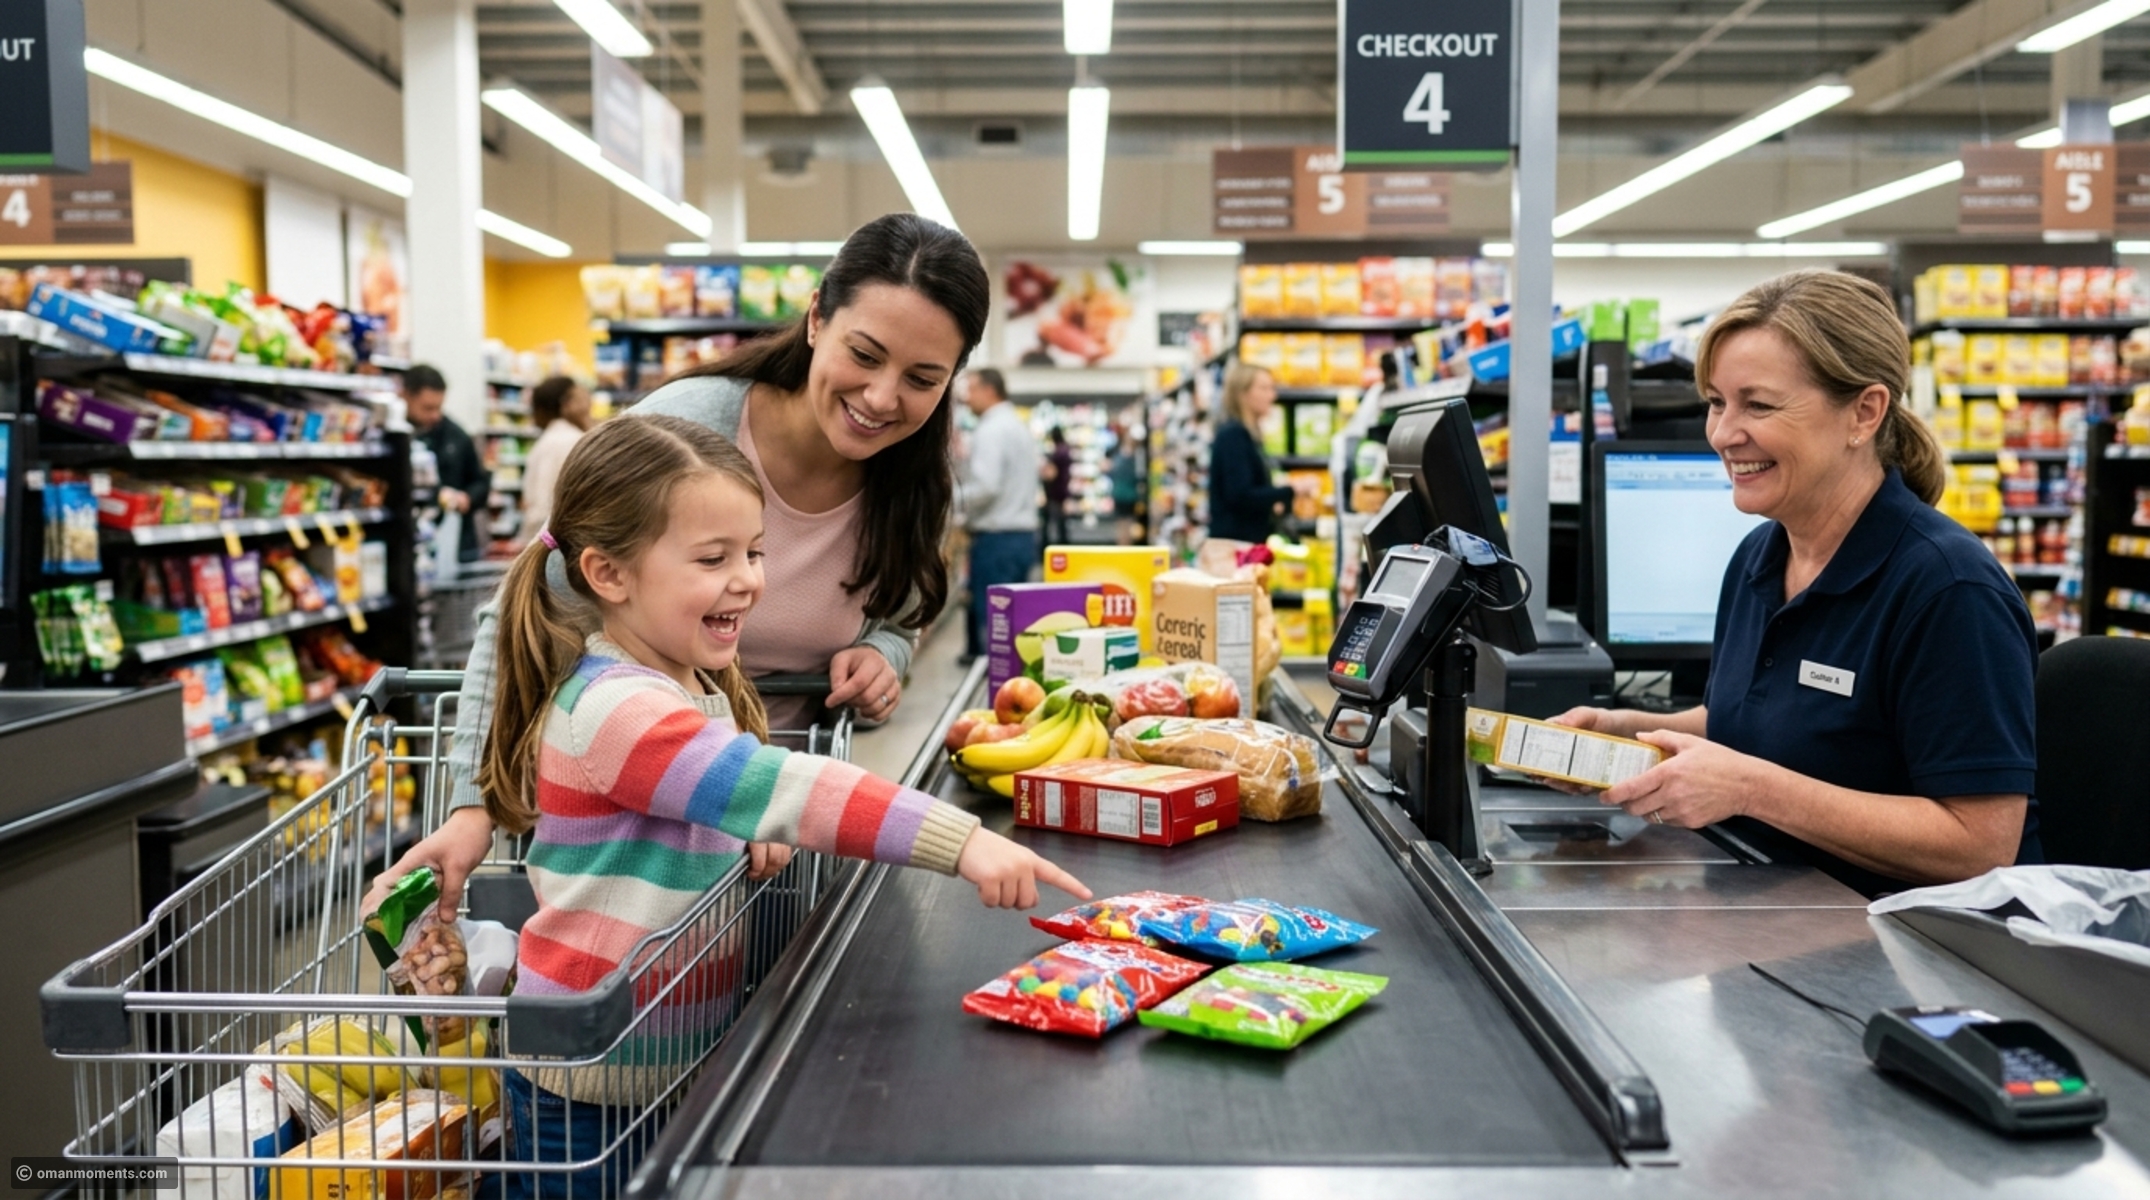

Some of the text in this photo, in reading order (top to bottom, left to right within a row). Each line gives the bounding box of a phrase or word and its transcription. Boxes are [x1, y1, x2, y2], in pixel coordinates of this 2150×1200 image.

[0, 38, 35, 61] UT
[1357, 33, 1498, 57] CHECKOUT
[1403, 72, 1451, 134] 4
[2, 189, 31, 228] 4
[1318, 175, 1345, 215] 5
[2065, 172, 2092, 213] 5
